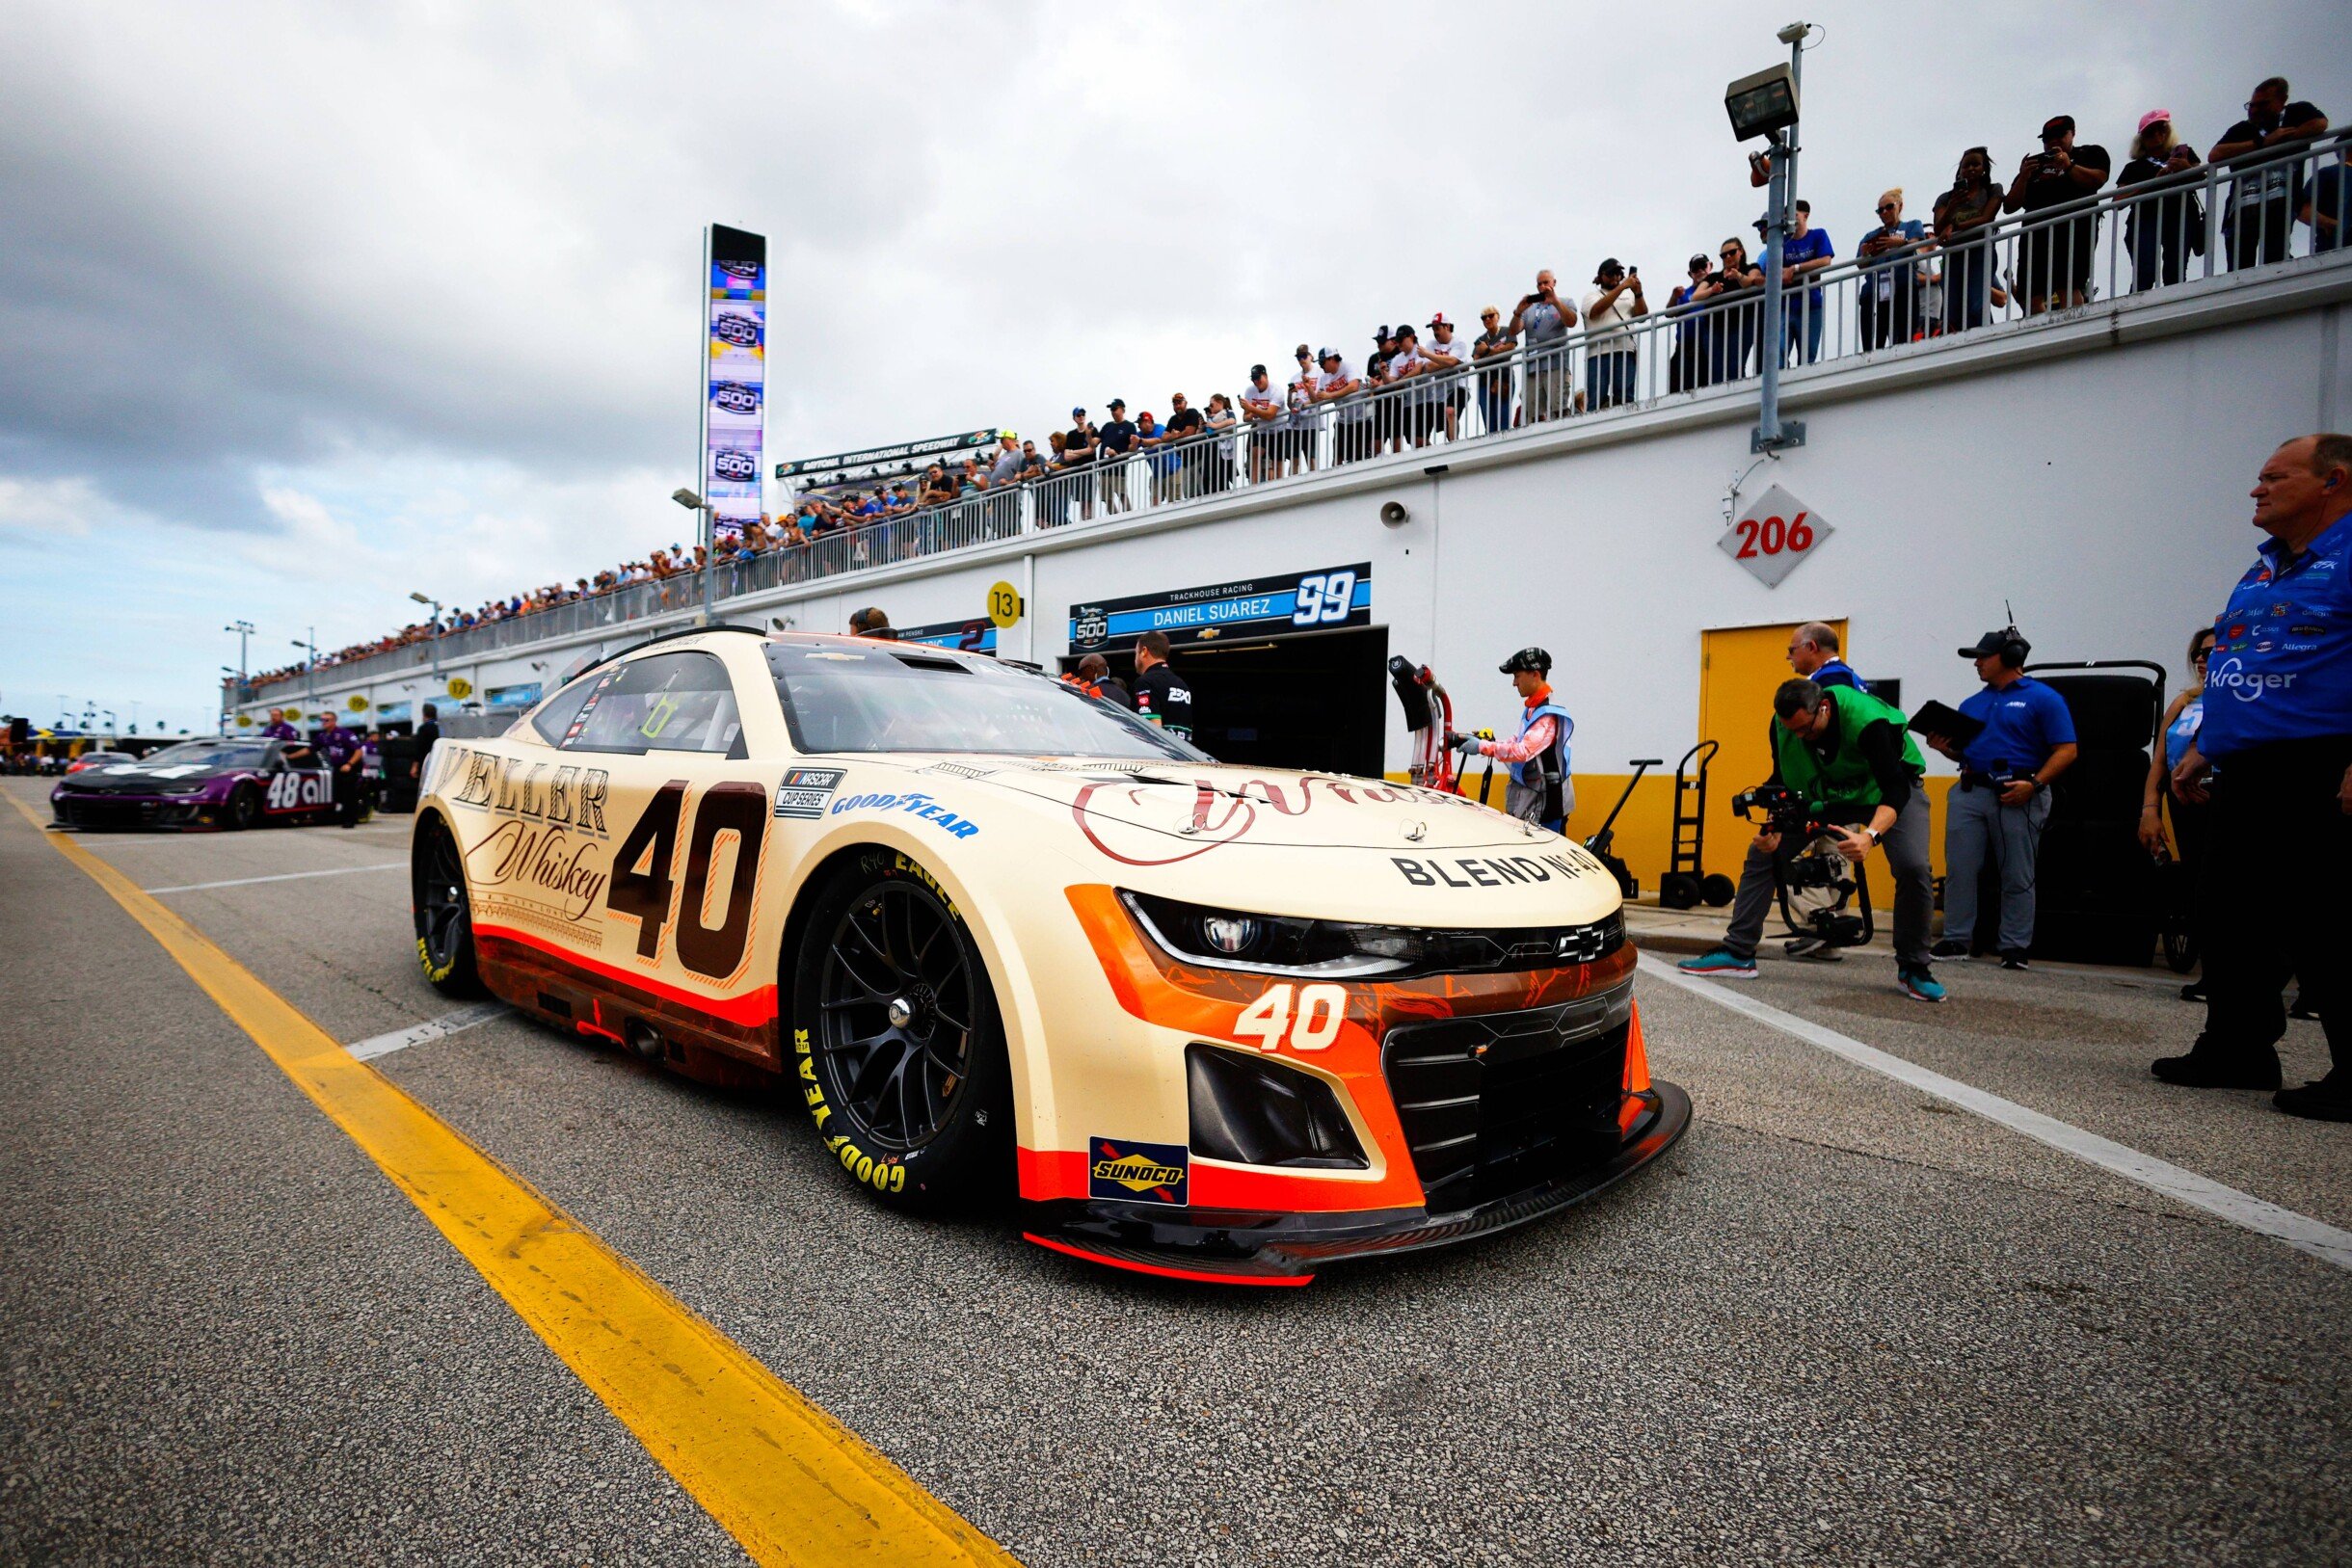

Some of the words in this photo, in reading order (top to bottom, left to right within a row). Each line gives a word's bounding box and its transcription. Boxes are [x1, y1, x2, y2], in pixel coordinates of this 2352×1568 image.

[719, 321, 756, 340] 500
[717, 390, 755, 407] 500
[716, 457, 754, 474] 500
[802, 457, 840, 470] DAYTONA
[842, 445, 910, 465] INTERNATIONAL
[911, 437, 960, 454] SPEEDWAY
[1736, 512, 1813, 560] 206
[993, 591, 1013, 617] 13
[1169, 589, 1220, 601] TRACKHOUSE
[1222, 583, 1253, 595] RACING
[1294, 572, 1355, 625] 99
[1153, 608, 1205, 626] DANIEL
[1208, 598, 1270, 620] SUÁREZ
[1076, 622, 1108, 639] 500
[2282, 643, 2317, 652] Allegra
[452, 680, 466, 695] 17
[2210, 657, 2297, 703] Kroger
[267, 772, 300, 810] 48
[798, 771, 834, 786] NASCAR
[782, 792, 799, 805] CUP
[799, 793, 824, 807] SERIES
[831, 793, 979, 839] GOODYEAR
[465, 819, 607, 921] Whiskey
[606, 779, 767, 979] 40
[1390, 857, 1551, 888] BLEND
[1565, 848, 1601, 875] 40
[1233, 983, 1350, 1053] 40
[793, 1028, 906, 1193] GOODYEAR
[1096, 1162, 1181, 1184] SUNOCO
